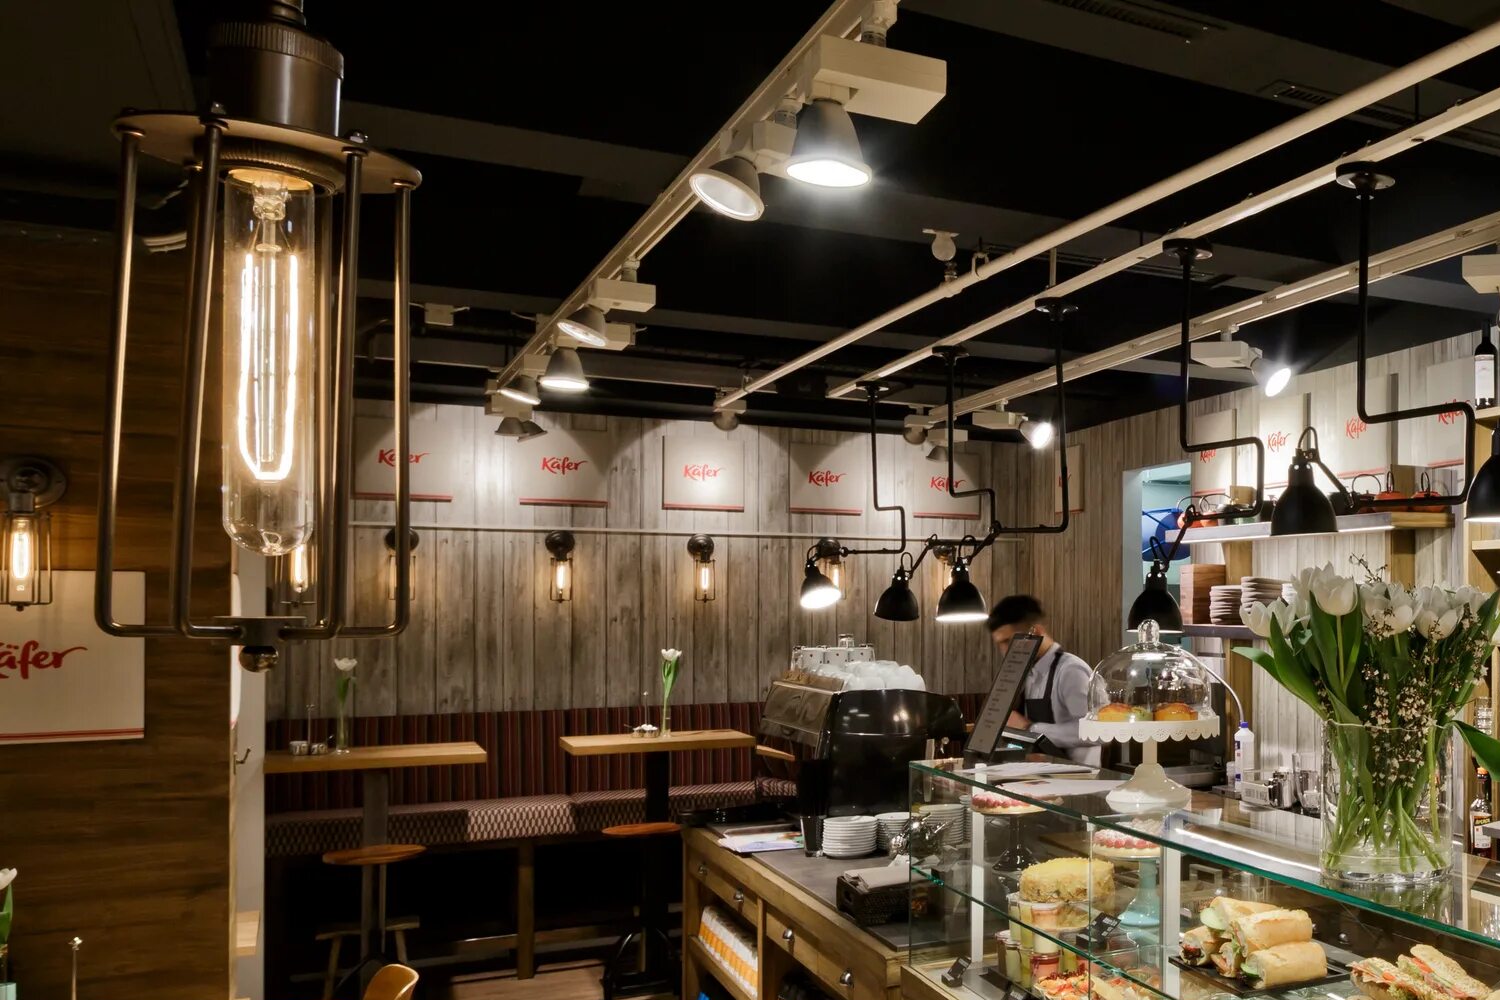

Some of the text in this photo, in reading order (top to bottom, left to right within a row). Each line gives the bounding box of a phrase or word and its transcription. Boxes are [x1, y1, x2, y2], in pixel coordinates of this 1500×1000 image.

[1268, 432, 1291, 452] Käfer
[542, 457, 588, 476] Käfer
[684, 464, 725, 481] Käfer
[809, 471, 846, 488] Käfer
[931, 476, 967, 492] Käfr
[0, 640, 88, 680] äfer
